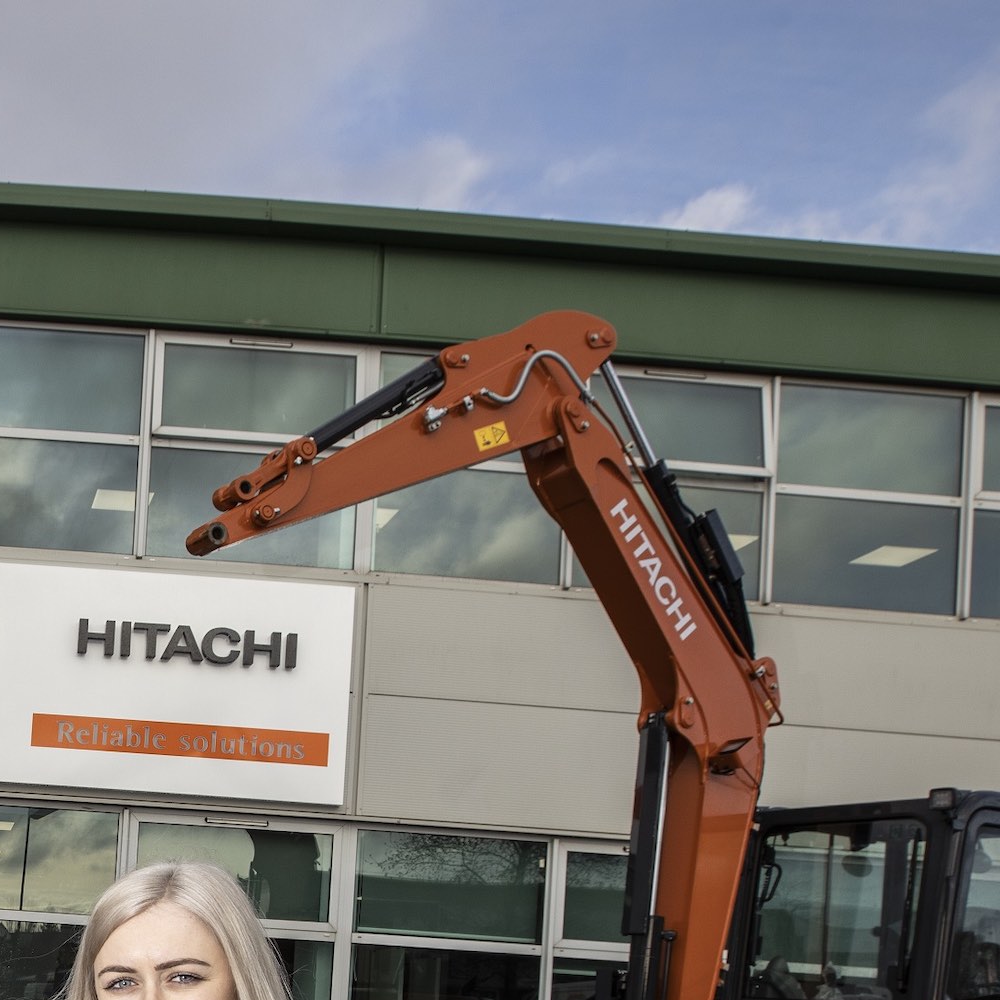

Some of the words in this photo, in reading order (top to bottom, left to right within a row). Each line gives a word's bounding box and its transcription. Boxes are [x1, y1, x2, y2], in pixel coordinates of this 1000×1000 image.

[610, 498, 697, 641] HITACHI
[77, 618, 299, 669] HITACHI
[56, 720, 167, 750] Reliable
[179, 731, 305, 760] solutions
